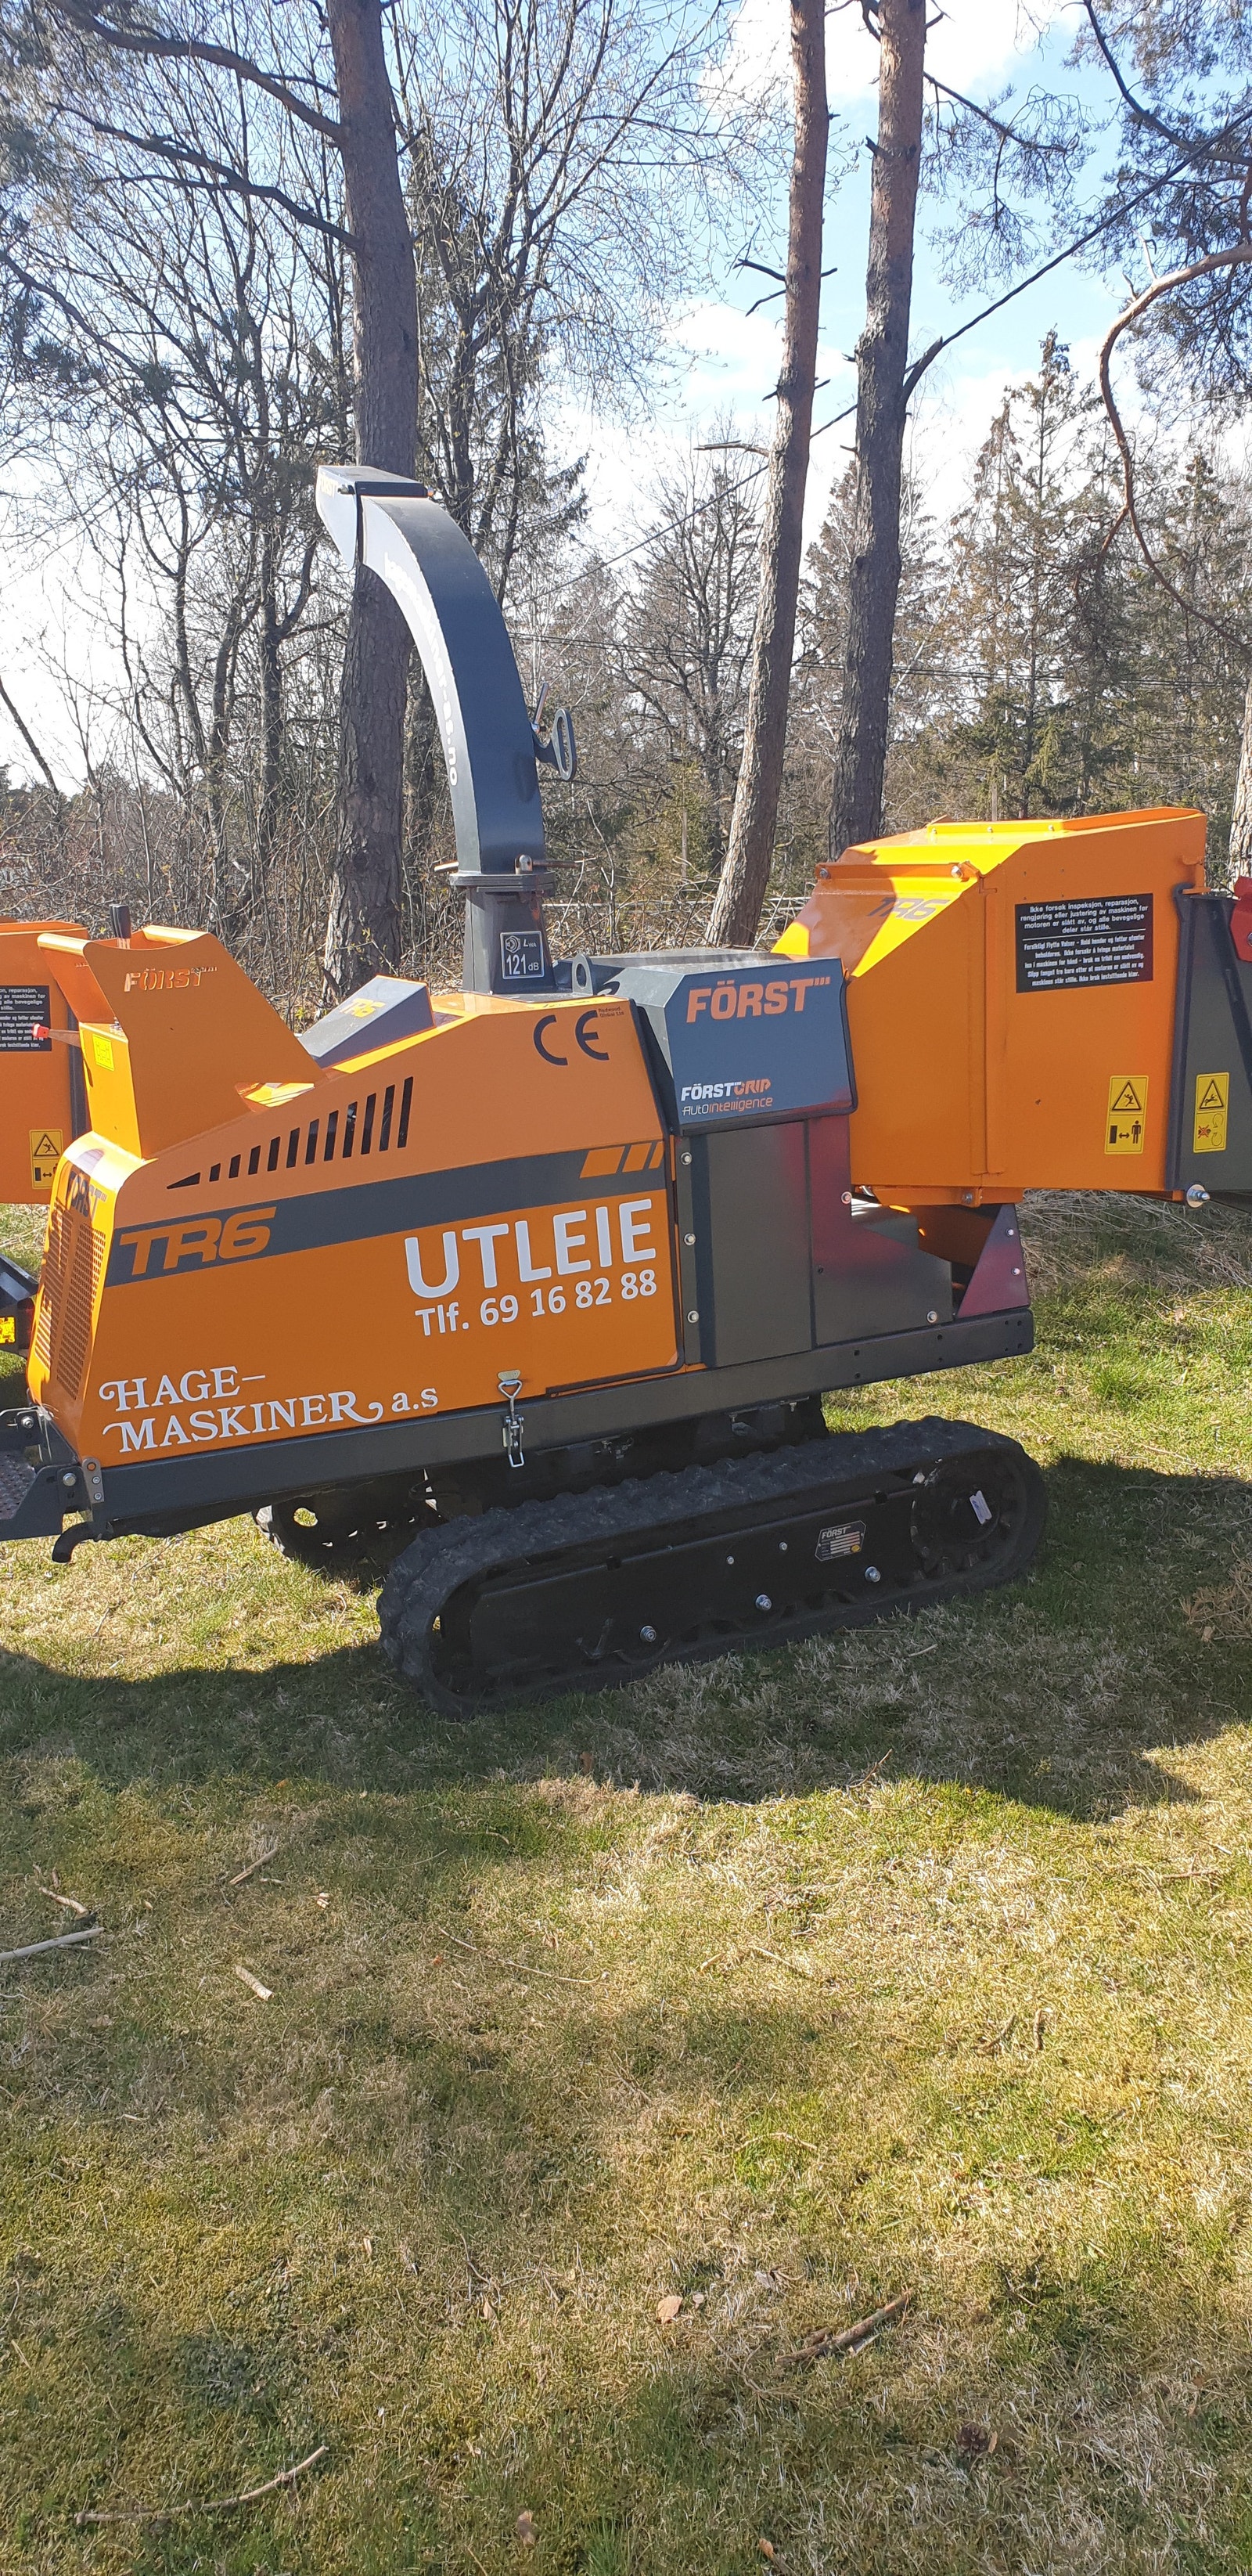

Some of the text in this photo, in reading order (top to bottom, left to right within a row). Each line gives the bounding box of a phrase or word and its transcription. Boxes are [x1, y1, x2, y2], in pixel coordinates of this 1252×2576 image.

[866, 896, 951, 921] TR6
[1068, 902, 1103, 911] inspeksjon,
[1105, 899, 1139, 908] reparasjon,
[1070, 909, 1097, 918] justering
[1108, 906, 1137, 914] maskinen
[1111, 913, 1145, 922] bevegelige
[124, 967, 207, 993] FÖRST
[506, 953, 540, 975] 121 dB
[685, 977, 816, 1024] FÖRST
[533, 1009, 610, 1066] CE
[119, 1205, 278, 1277] TR6
[404, 1198, 657, 1299] UTLEIE
[415, 1269, 657, 1336] Tlf. 69 16 82 88
[102, 1387, 439, 1454] MASKINER a.s
